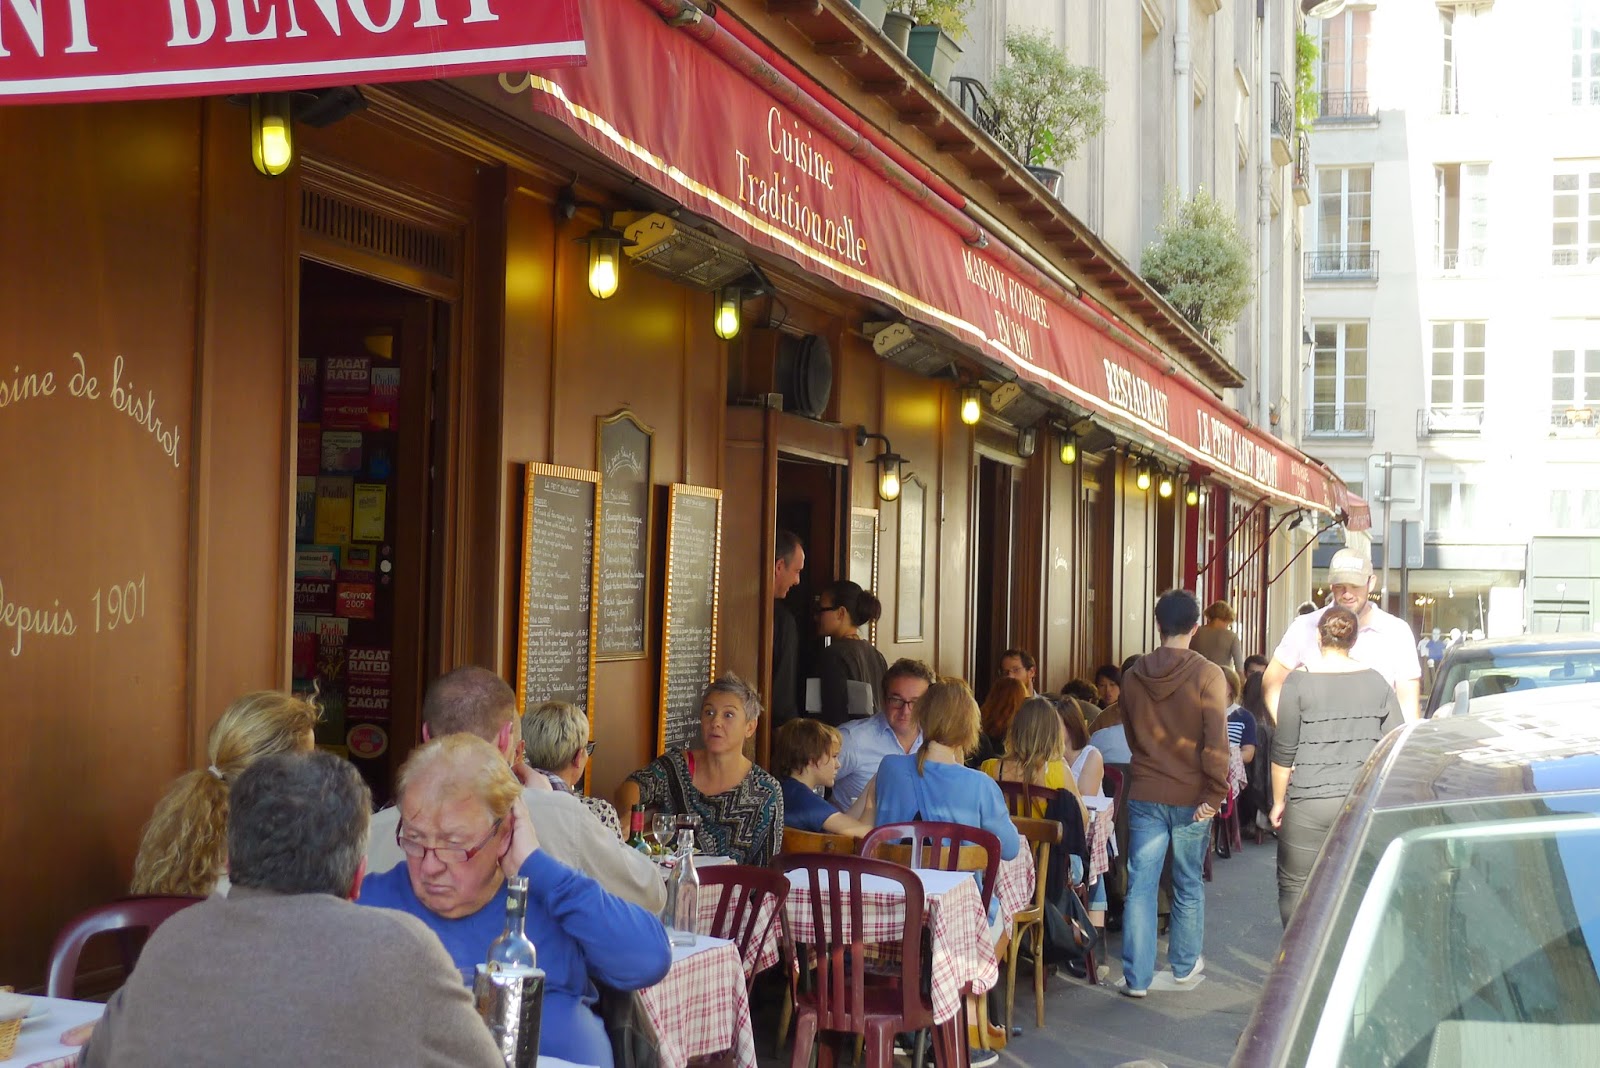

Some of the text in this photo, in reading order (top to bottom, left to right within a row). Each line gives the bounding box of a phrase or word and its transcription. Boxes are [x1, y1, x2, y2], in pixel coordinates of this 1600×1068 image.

[167, 0, 499, 47] BEN
[767, 106, 834, 190] Cuisine
[735, 149, 867, 266] Traditionnelle
[961, 247, 1007, 304] MAISON
[994, 309, 1011, 347] EN
[327, 358, 369, 369] ZAGAT
[327, 369, 368, 381] RATED
[1103, 358, 1169, 431] RESTAURANT
[69, 352, 100, 400] de
[110, 355, 180, 468] bistrot
[1197, 408, 1211, 455] LE
[1211, 416, 1233, 466] PETIT
[1233, 430, 1255, 476] SAINT
[294, 583, 330, 594] ZAGAT
[92, 572, 146, 633] 1901
[345, 600, 365, 609] 2005
[320, 634, 344, 646] PARIS
[348, 660, 390, 672] RATED
[349, 649, 391, 661] ZAGAT
[347, 697, 390, 710] ZAGAT
[348, 685, 390, 697] Coté par
